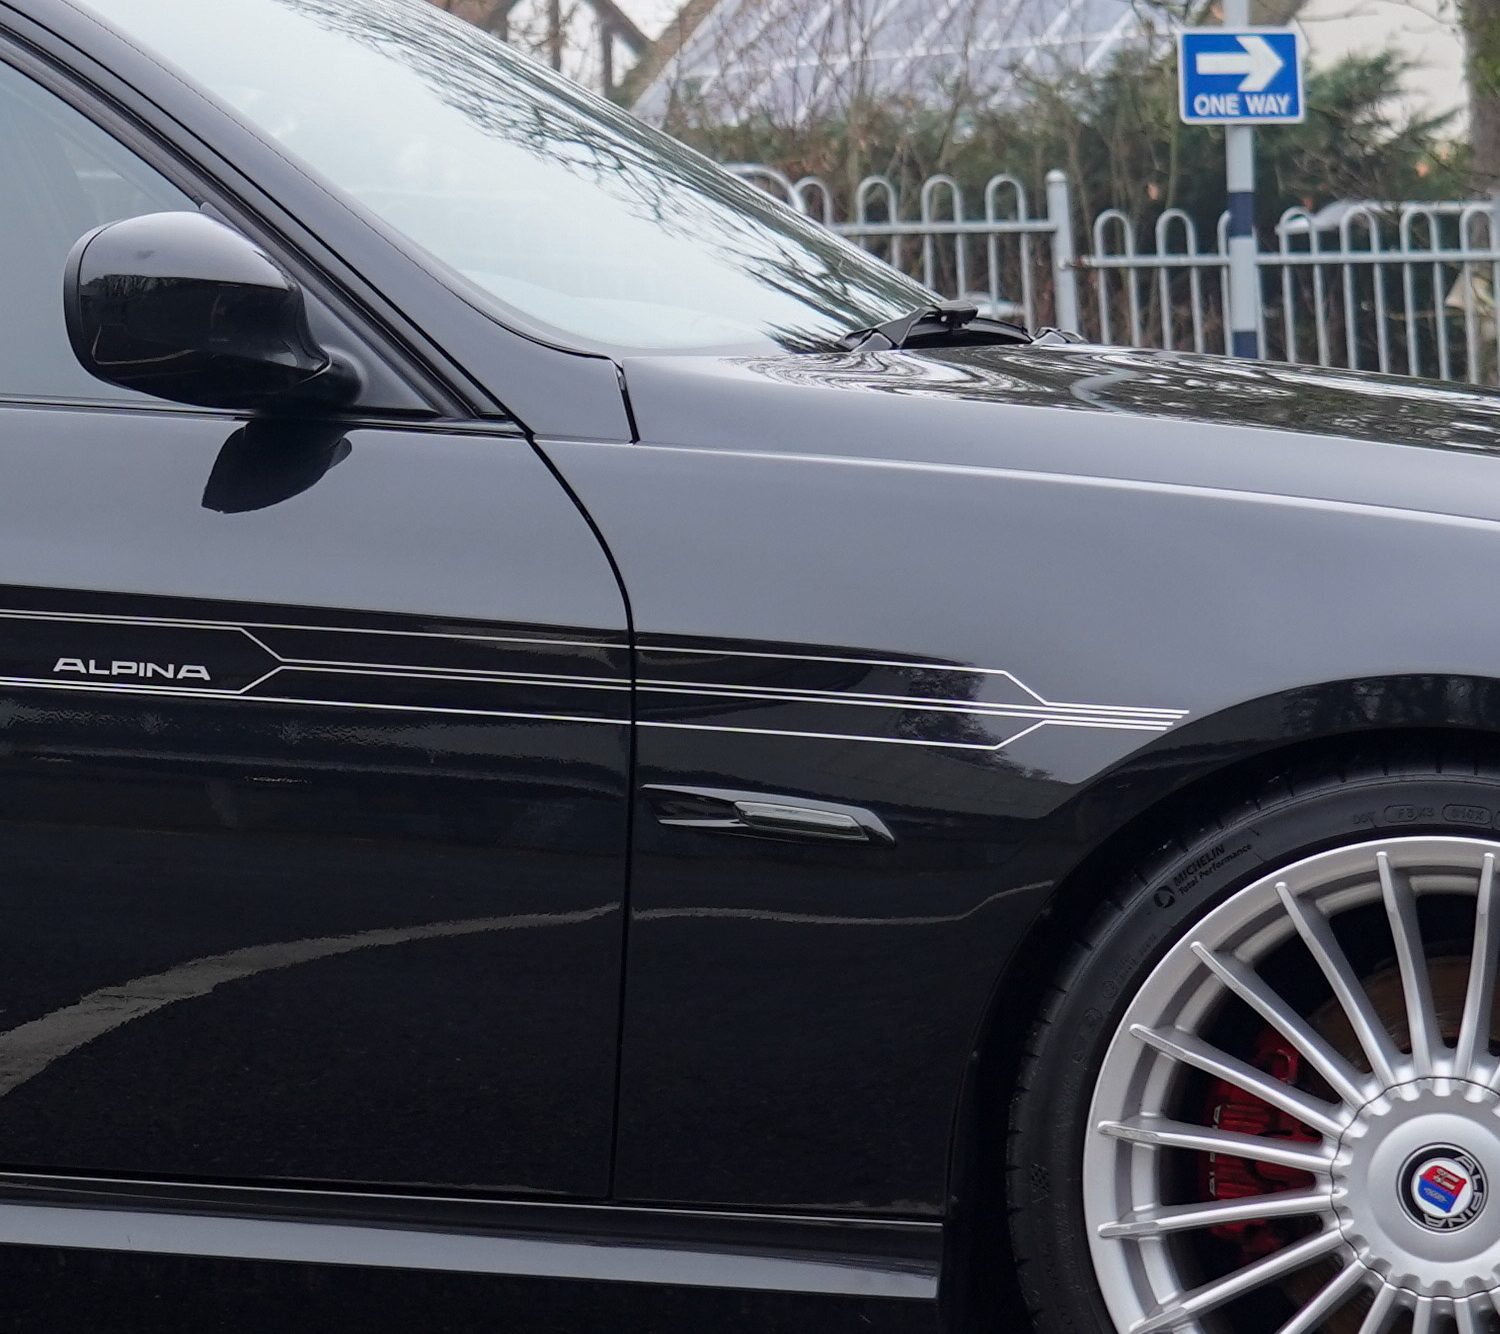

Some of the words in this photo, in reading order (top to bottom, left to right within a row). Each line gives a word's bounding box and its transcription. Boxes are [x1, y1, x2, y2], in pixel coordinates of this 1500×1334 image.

[1194, 93, 1240, 116] ONE
[1245, 92, 1290, 115] WAY
[53, 657, 212, 681] ALPINA
[1173, 844, 1225, 886] MICHELIN
[1423, 1155, 1484, 1227] ALPINA
